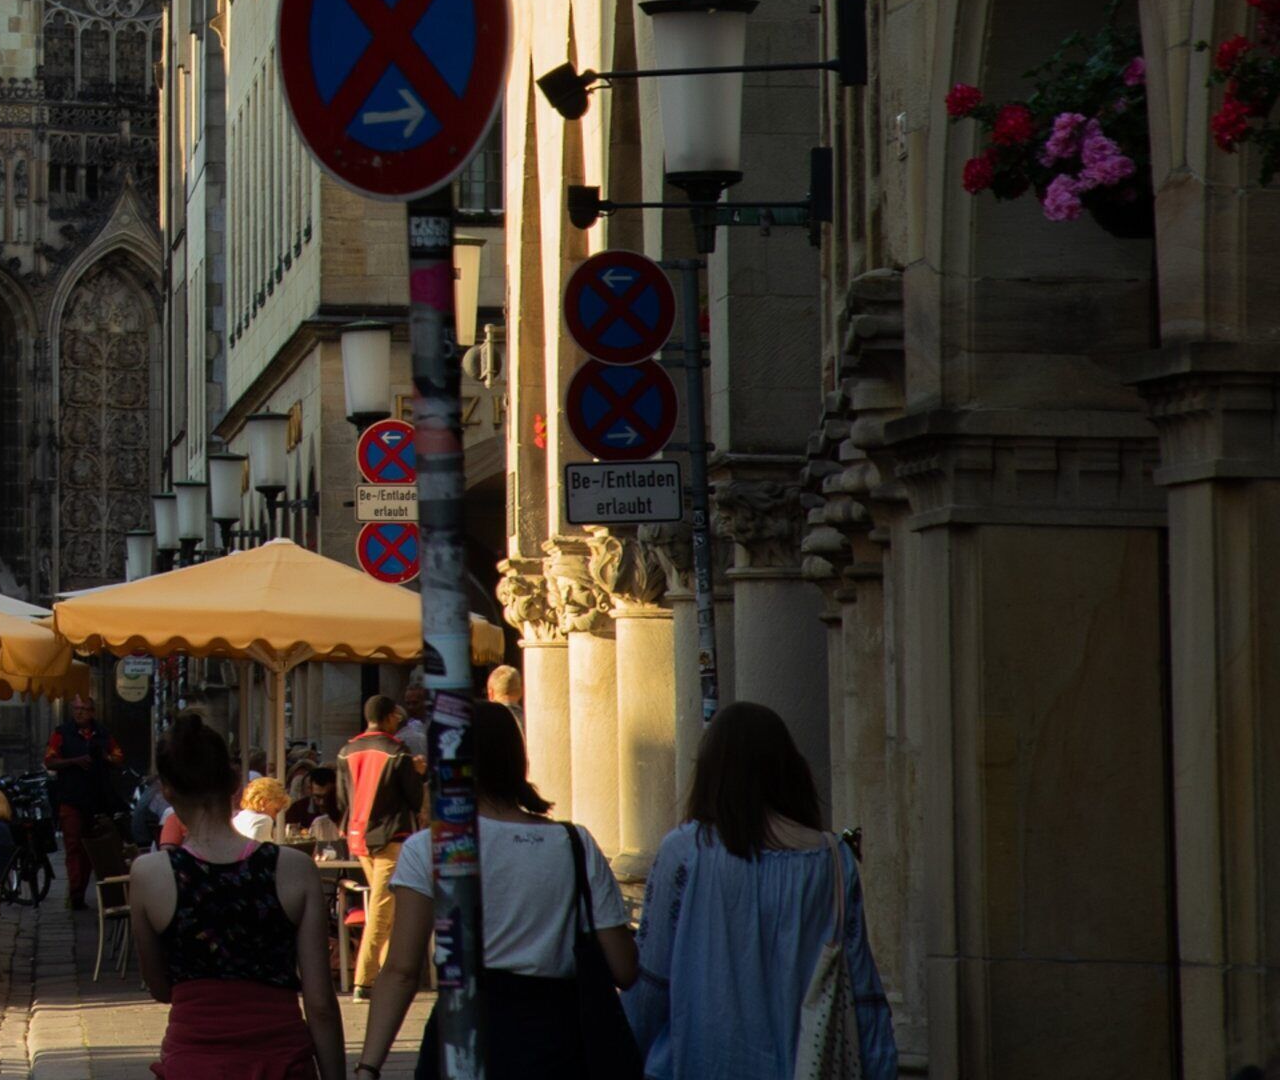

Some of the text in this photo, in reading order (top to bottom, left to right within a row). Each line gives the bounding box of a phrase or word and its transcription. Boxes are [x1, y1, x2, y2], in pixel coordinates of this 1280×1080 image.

[571, 470, 675, 489] Be-/Entladen
[359, 489, 417, 501] Be-/Entlade
[374, 505, 408, 517] erlaubt
[596, 496, 653, 515] erlaubt
